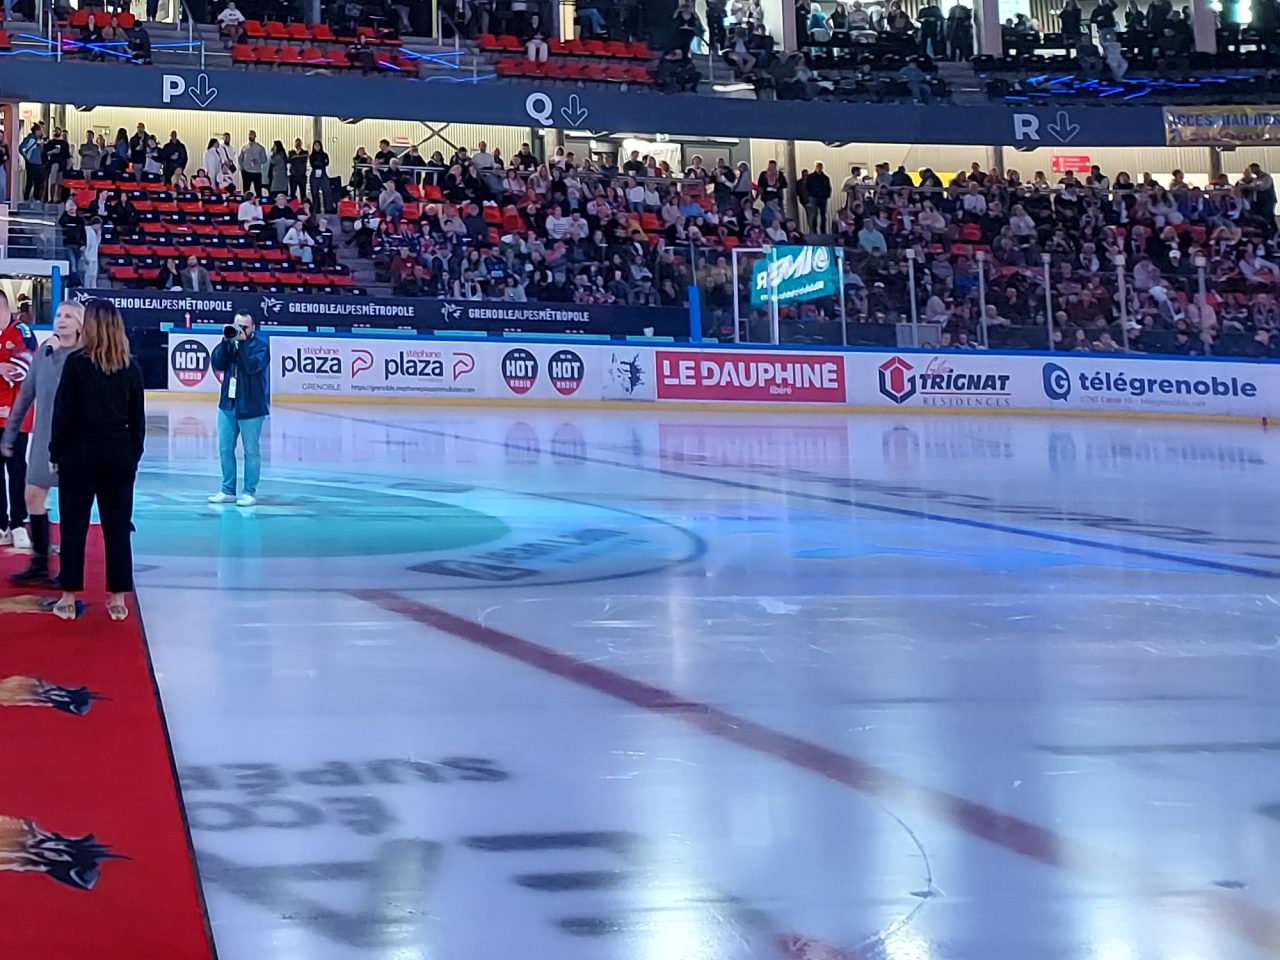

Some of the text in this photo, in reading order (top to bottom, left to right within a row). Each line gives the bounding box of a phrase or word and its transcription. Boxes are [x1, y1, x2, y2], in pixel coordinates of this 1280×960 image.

[162, 74, 186, 103] P
[525, 91, 555, 127] Q
[1013, 114, 1040, 141] R
[176, 351, 206, 369] HOT
[282, 348, 342, 378] plaza
[303, 347, 339, 357] stéphane
[385, 351, 444, 381] plaza
[506, 360, 534, 377] HOT
[552, 361, 581, 378] HOT
[663, 359, 696, 385] LE
[302, 383, 342, 391] GRENOBLE
[510, 380, 531, 388] RADIO
[556, 381, 577, 389] RADIO
[1079, 371, 1257, 397] télégrenoble
